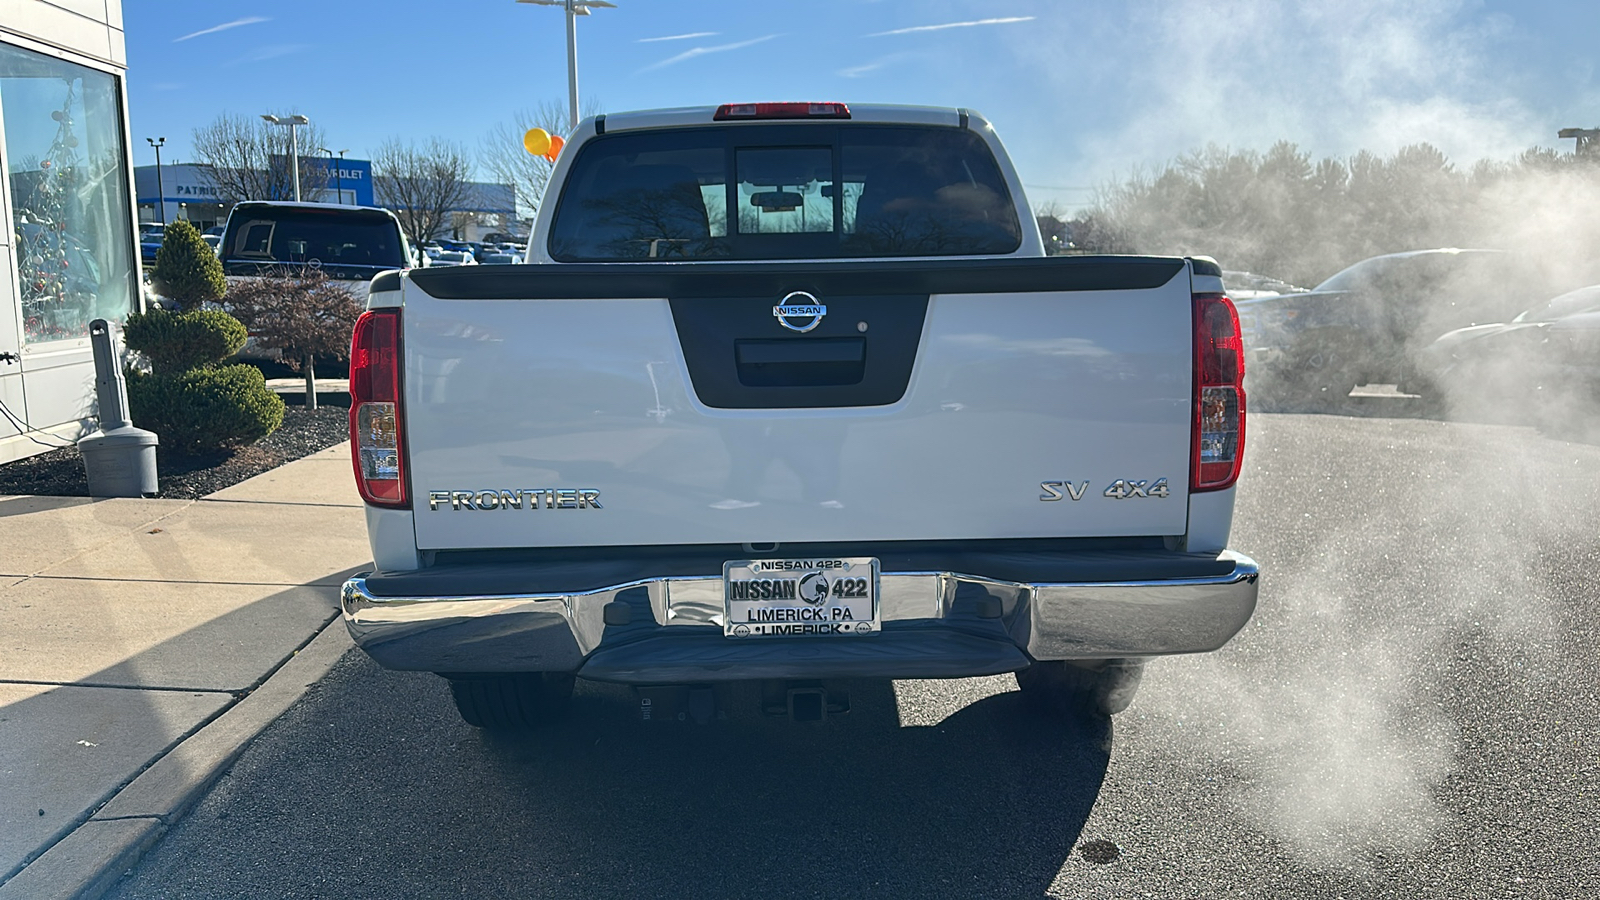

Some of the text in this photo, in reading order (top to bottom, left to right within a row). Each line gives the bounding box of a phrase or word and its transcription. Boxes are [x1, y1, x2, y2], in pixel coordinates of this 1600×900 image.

[779, 307, 821, 315] NISSAN
[1039, 480, 1090, 501] SV
[429, 488, 603, 511] FRONTIER
[761, 560, 843, 570] NISSAN 422
[730, 577, 868, 601] NISSAN 422
[748, 607, 853, 621] LIMERICK, PA
[761, 623, 843, 636] LIMERICK
